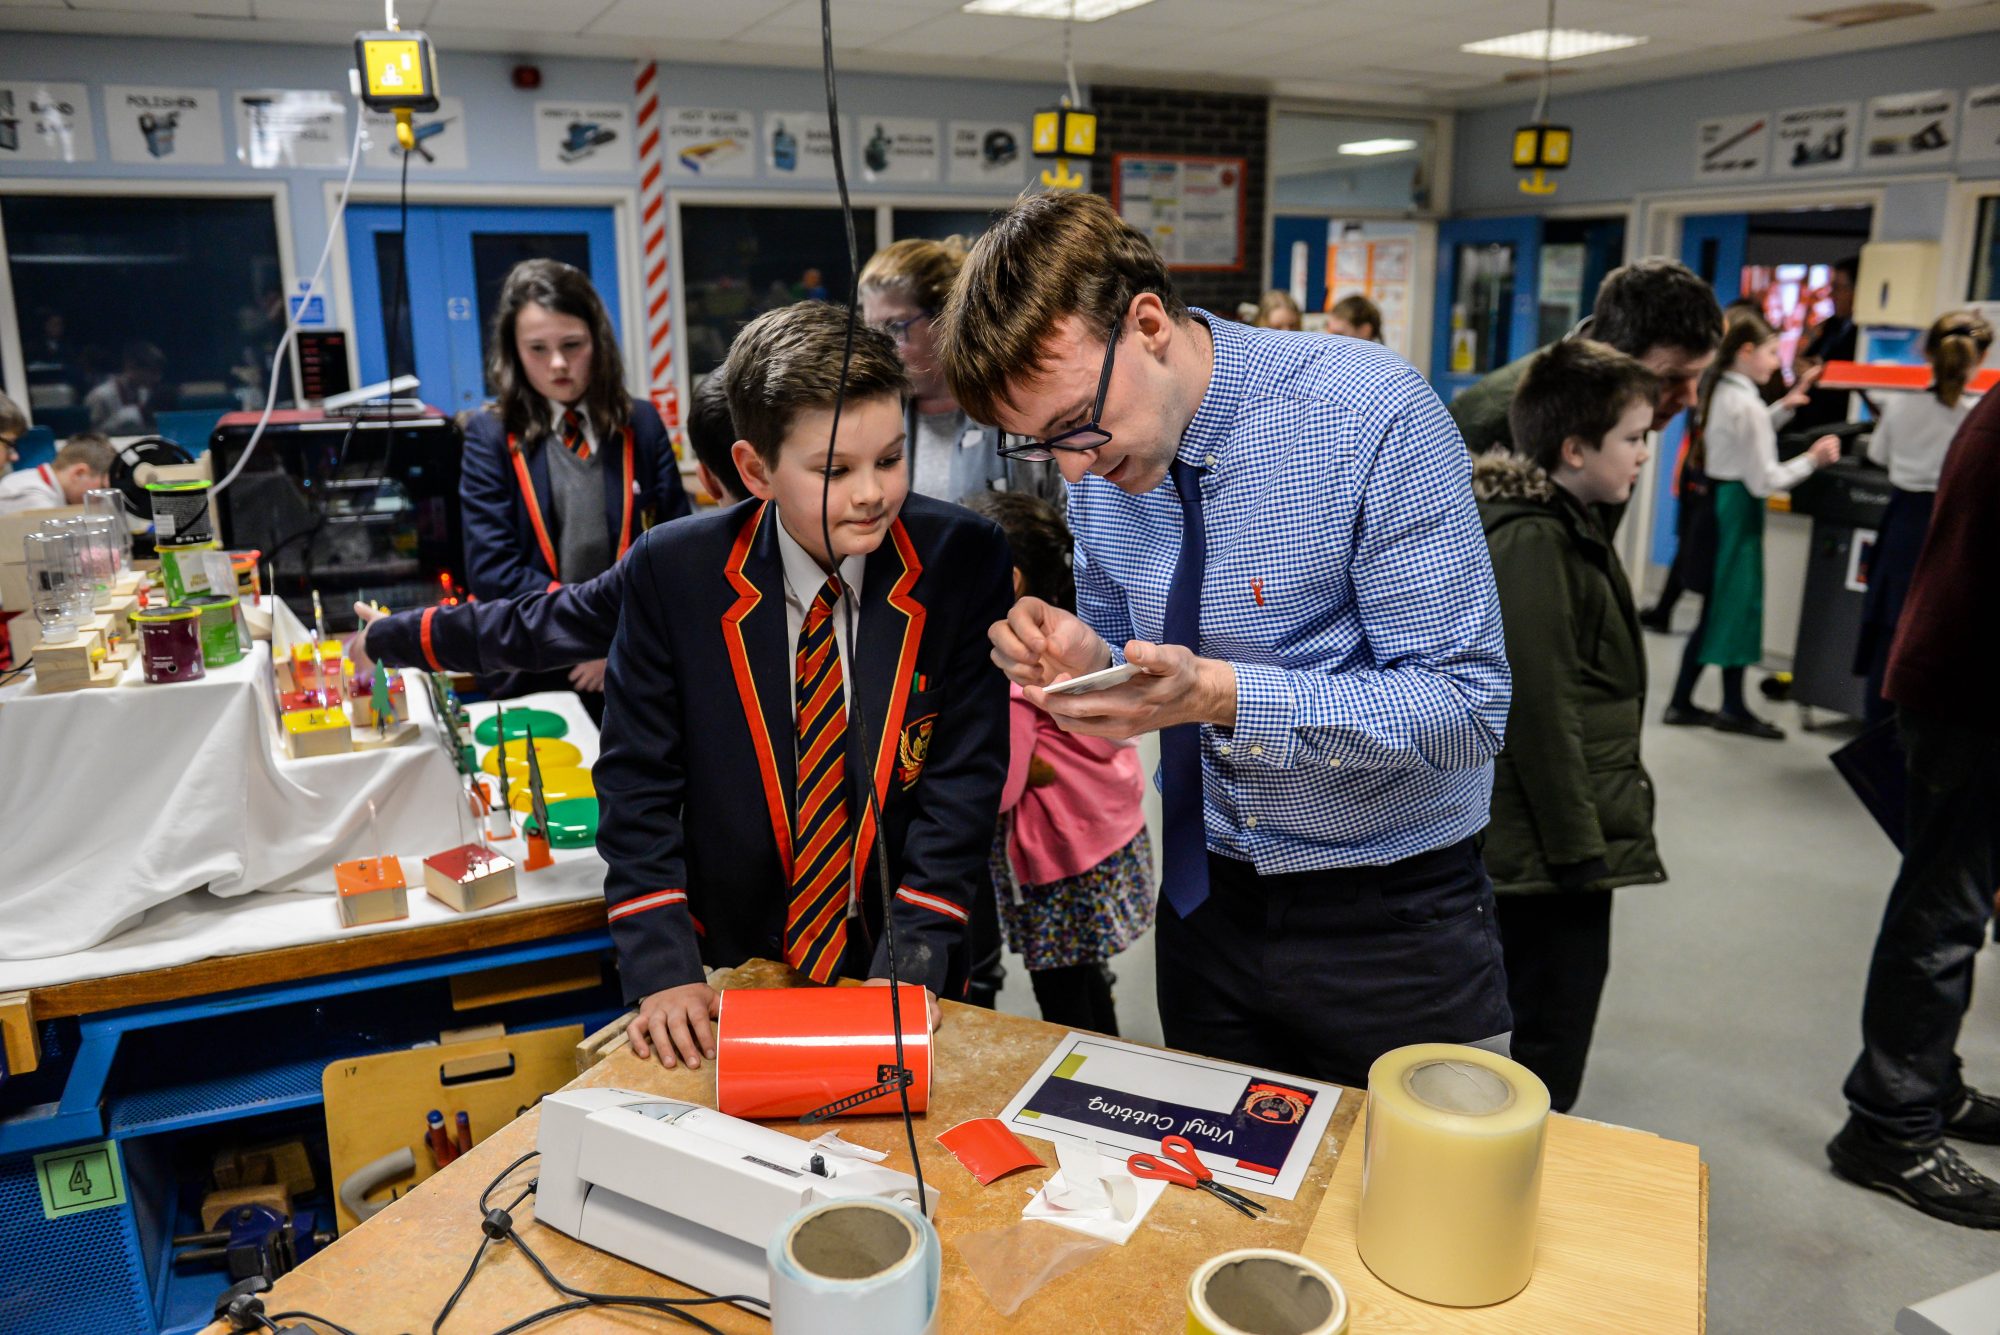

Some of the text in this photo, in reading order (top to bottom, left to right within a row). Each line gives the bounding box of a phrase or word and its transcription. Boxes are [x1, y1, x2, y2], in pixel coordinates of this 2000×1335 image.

[126, 94, 198, 109] POLISHER
[1088, 1096, 1234, 1146] Vinyl Cutting
[69, 1160, 93, 1196] 4
